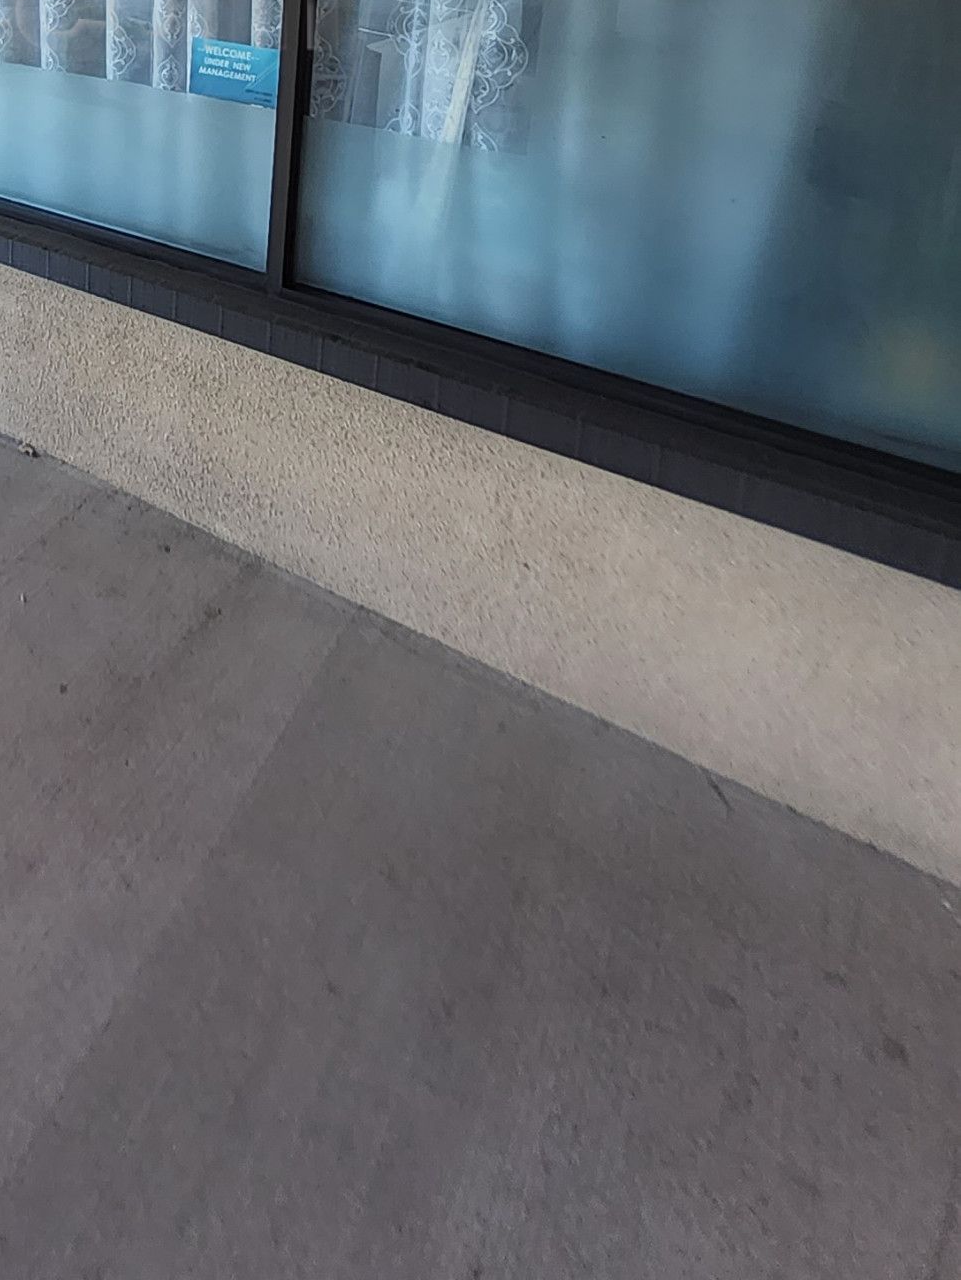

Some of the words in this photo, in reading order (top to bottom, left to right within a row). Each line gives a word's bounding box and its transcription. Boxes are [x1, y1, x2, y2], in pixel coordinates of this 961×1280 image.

[204, 56, 230, 69] UNDER
[232, 61, 251, 72] NEW
[198, 65, 257, 83] MANAGEMENT
